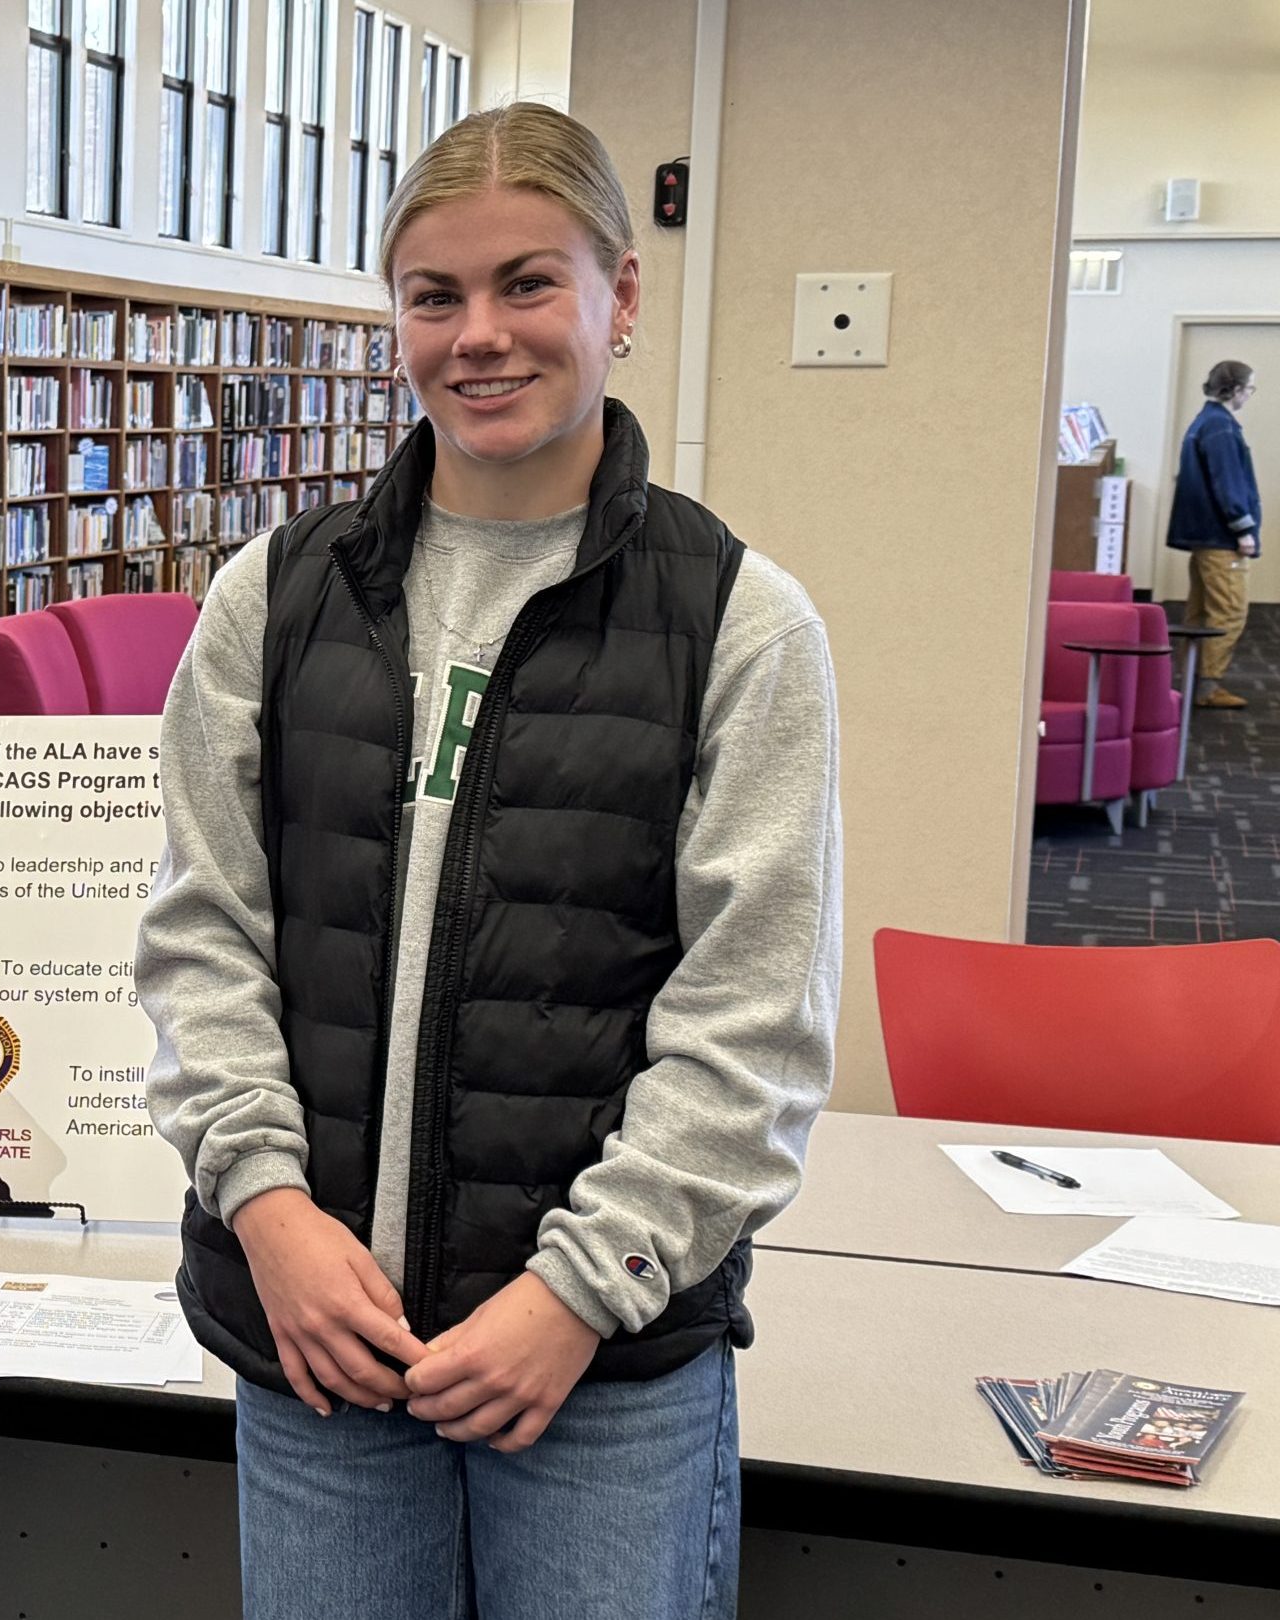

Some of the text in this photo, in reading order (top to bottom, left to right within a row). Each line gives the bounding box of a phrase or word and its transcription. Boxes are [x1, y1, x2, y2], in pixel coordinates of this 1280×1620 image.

[6, 743, 37, 760] the
[43, 743, 88, 760] ALA
[93, 743, 142, 760] have
[149, 746, 160, 760] s
[58, 771, 146, 793] Program
[152, 773, 160, 789] t
[80, 800, 164, 823] objectiv
[11, 856, 104, 876] leadership
[110, 857, 144, 873] and
[149, 861, 160, 877] p
[14, 882, 33, 898] of
[37, 882, 65, 898] the
[72, 882, 130, 898] United
[136, 882, 154, 899] S
[1, 959, 134, 977] To educate citi
[0, 987, 140, 1007] our system of g
[69, 1065, 145, 1082] To instill
[68, 1092, 149, 1109] understa
[65, 1118, 154, 1136] American
